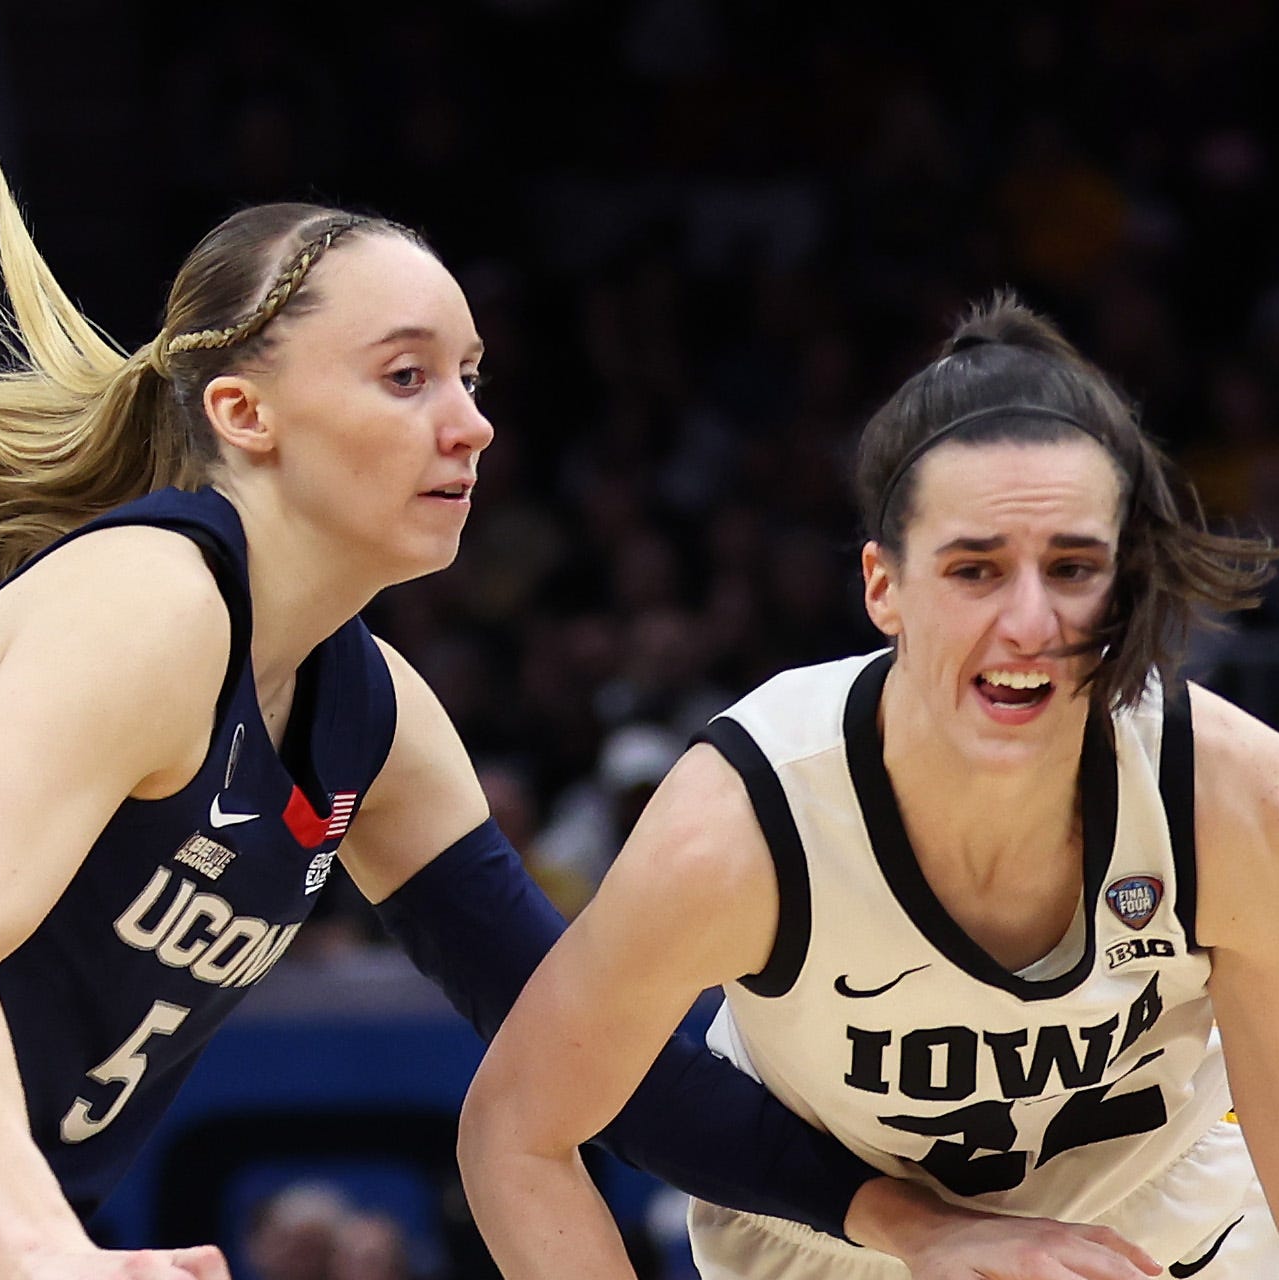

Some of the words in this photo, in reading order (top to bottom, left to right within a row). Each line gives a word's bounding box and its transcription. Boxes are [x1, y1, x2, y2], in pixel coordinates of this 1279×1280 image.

[173, 848, 224, 881] CHANGE
[1118, 885, 1151, 901] FINAL
[1120, 898, 1153, 915] FOUR
[844, 970, 1164, 1101] IOWA
[60, 999, 191, 1144] 5
